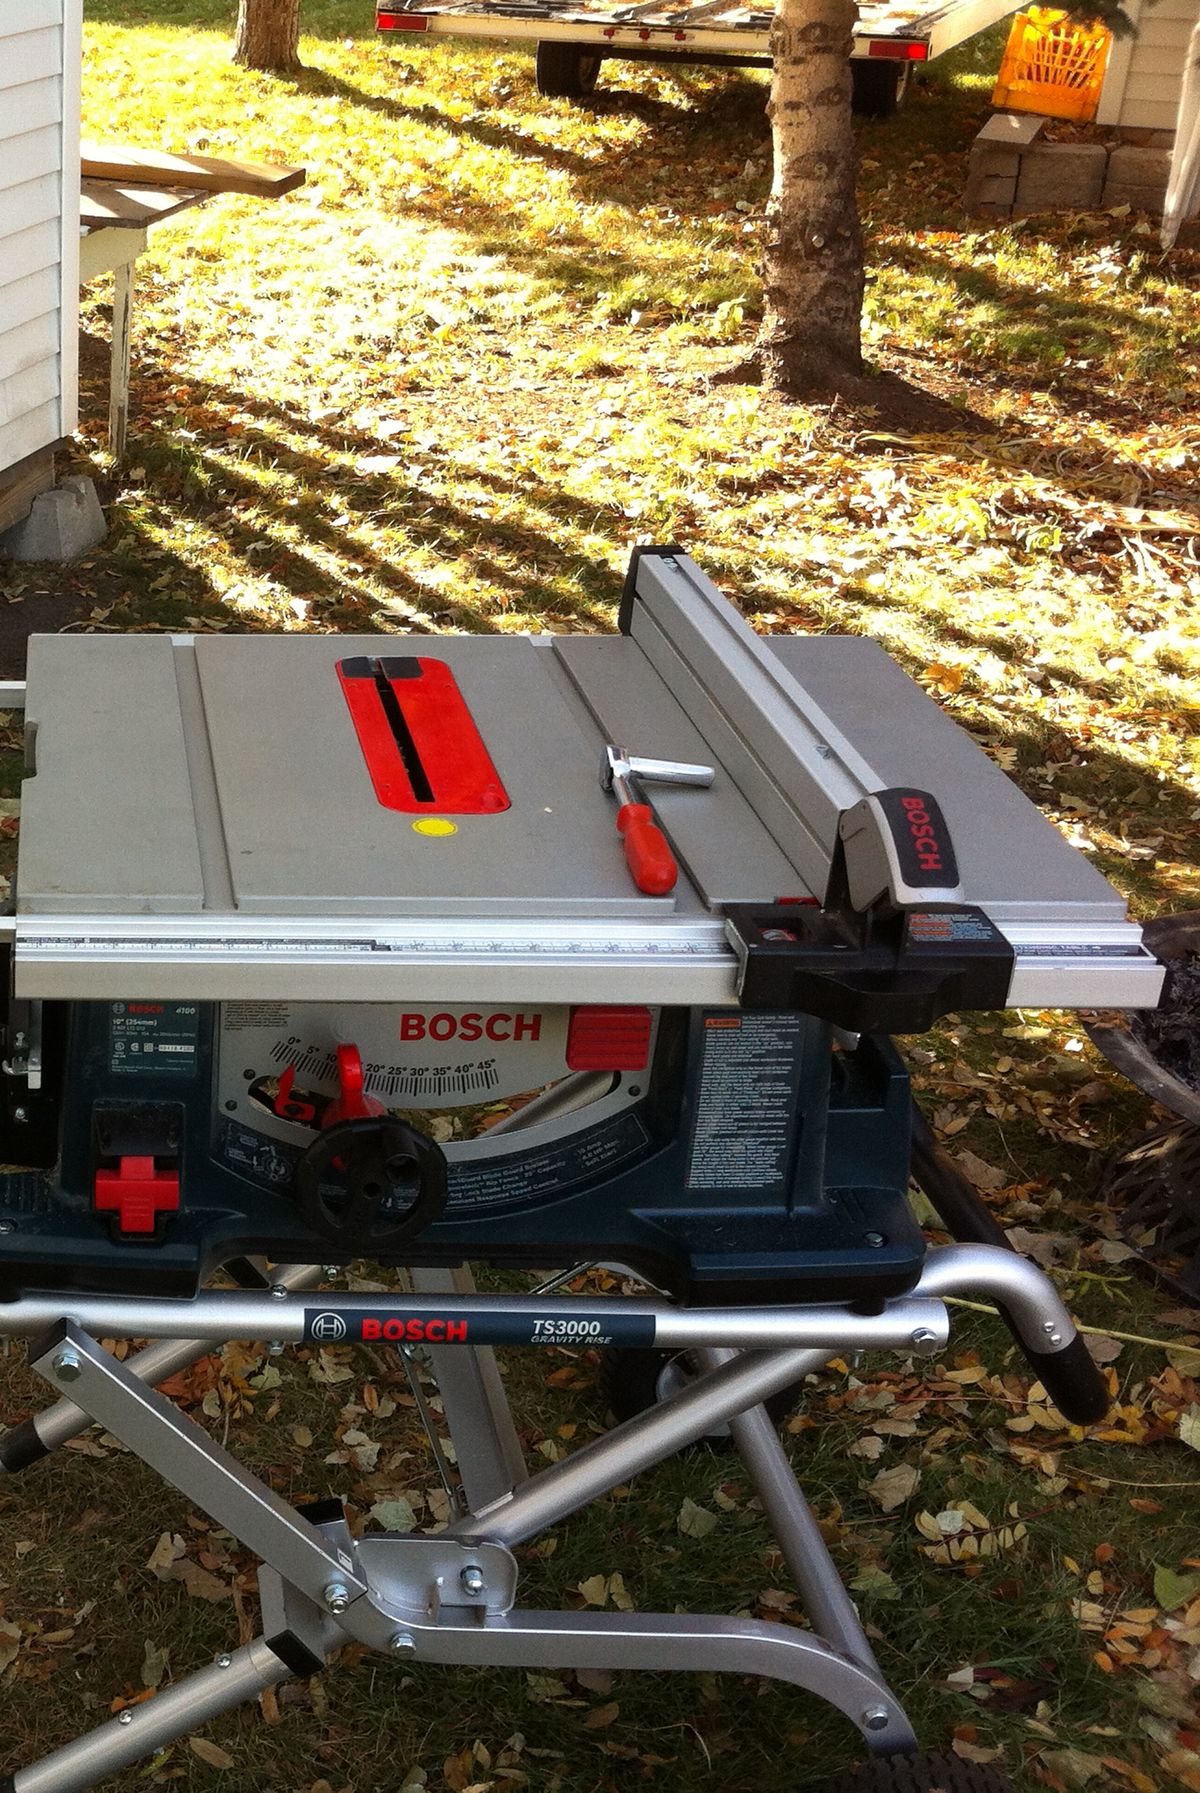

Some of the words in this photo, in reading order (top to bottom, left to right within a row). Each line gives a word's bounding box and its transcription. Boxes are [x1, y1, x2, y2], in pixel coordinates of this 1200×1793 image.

[901, 797, 943, 870] BOSCH
[400, 1013, 542, 1041] BOSCH
[326, 1053, 338, 1062] 10
[365, 1063, 385, 1073] 20°
[388, 1066, 407, 1075] 25°
[410, 1067, 429, 1076] 30°
[432, 1066, 452, 1076] 35°
[454, 1063, 474, 1074] 40°
[477, 1058, 496, 1070] 45°
[362, 1318, 468, 1342] BOSCH
[533, 1320, 601, 1336] TS3000
[530, 1335, 583, 1344] GRAVITY
[584, 1336, 614, 1345] RISE
